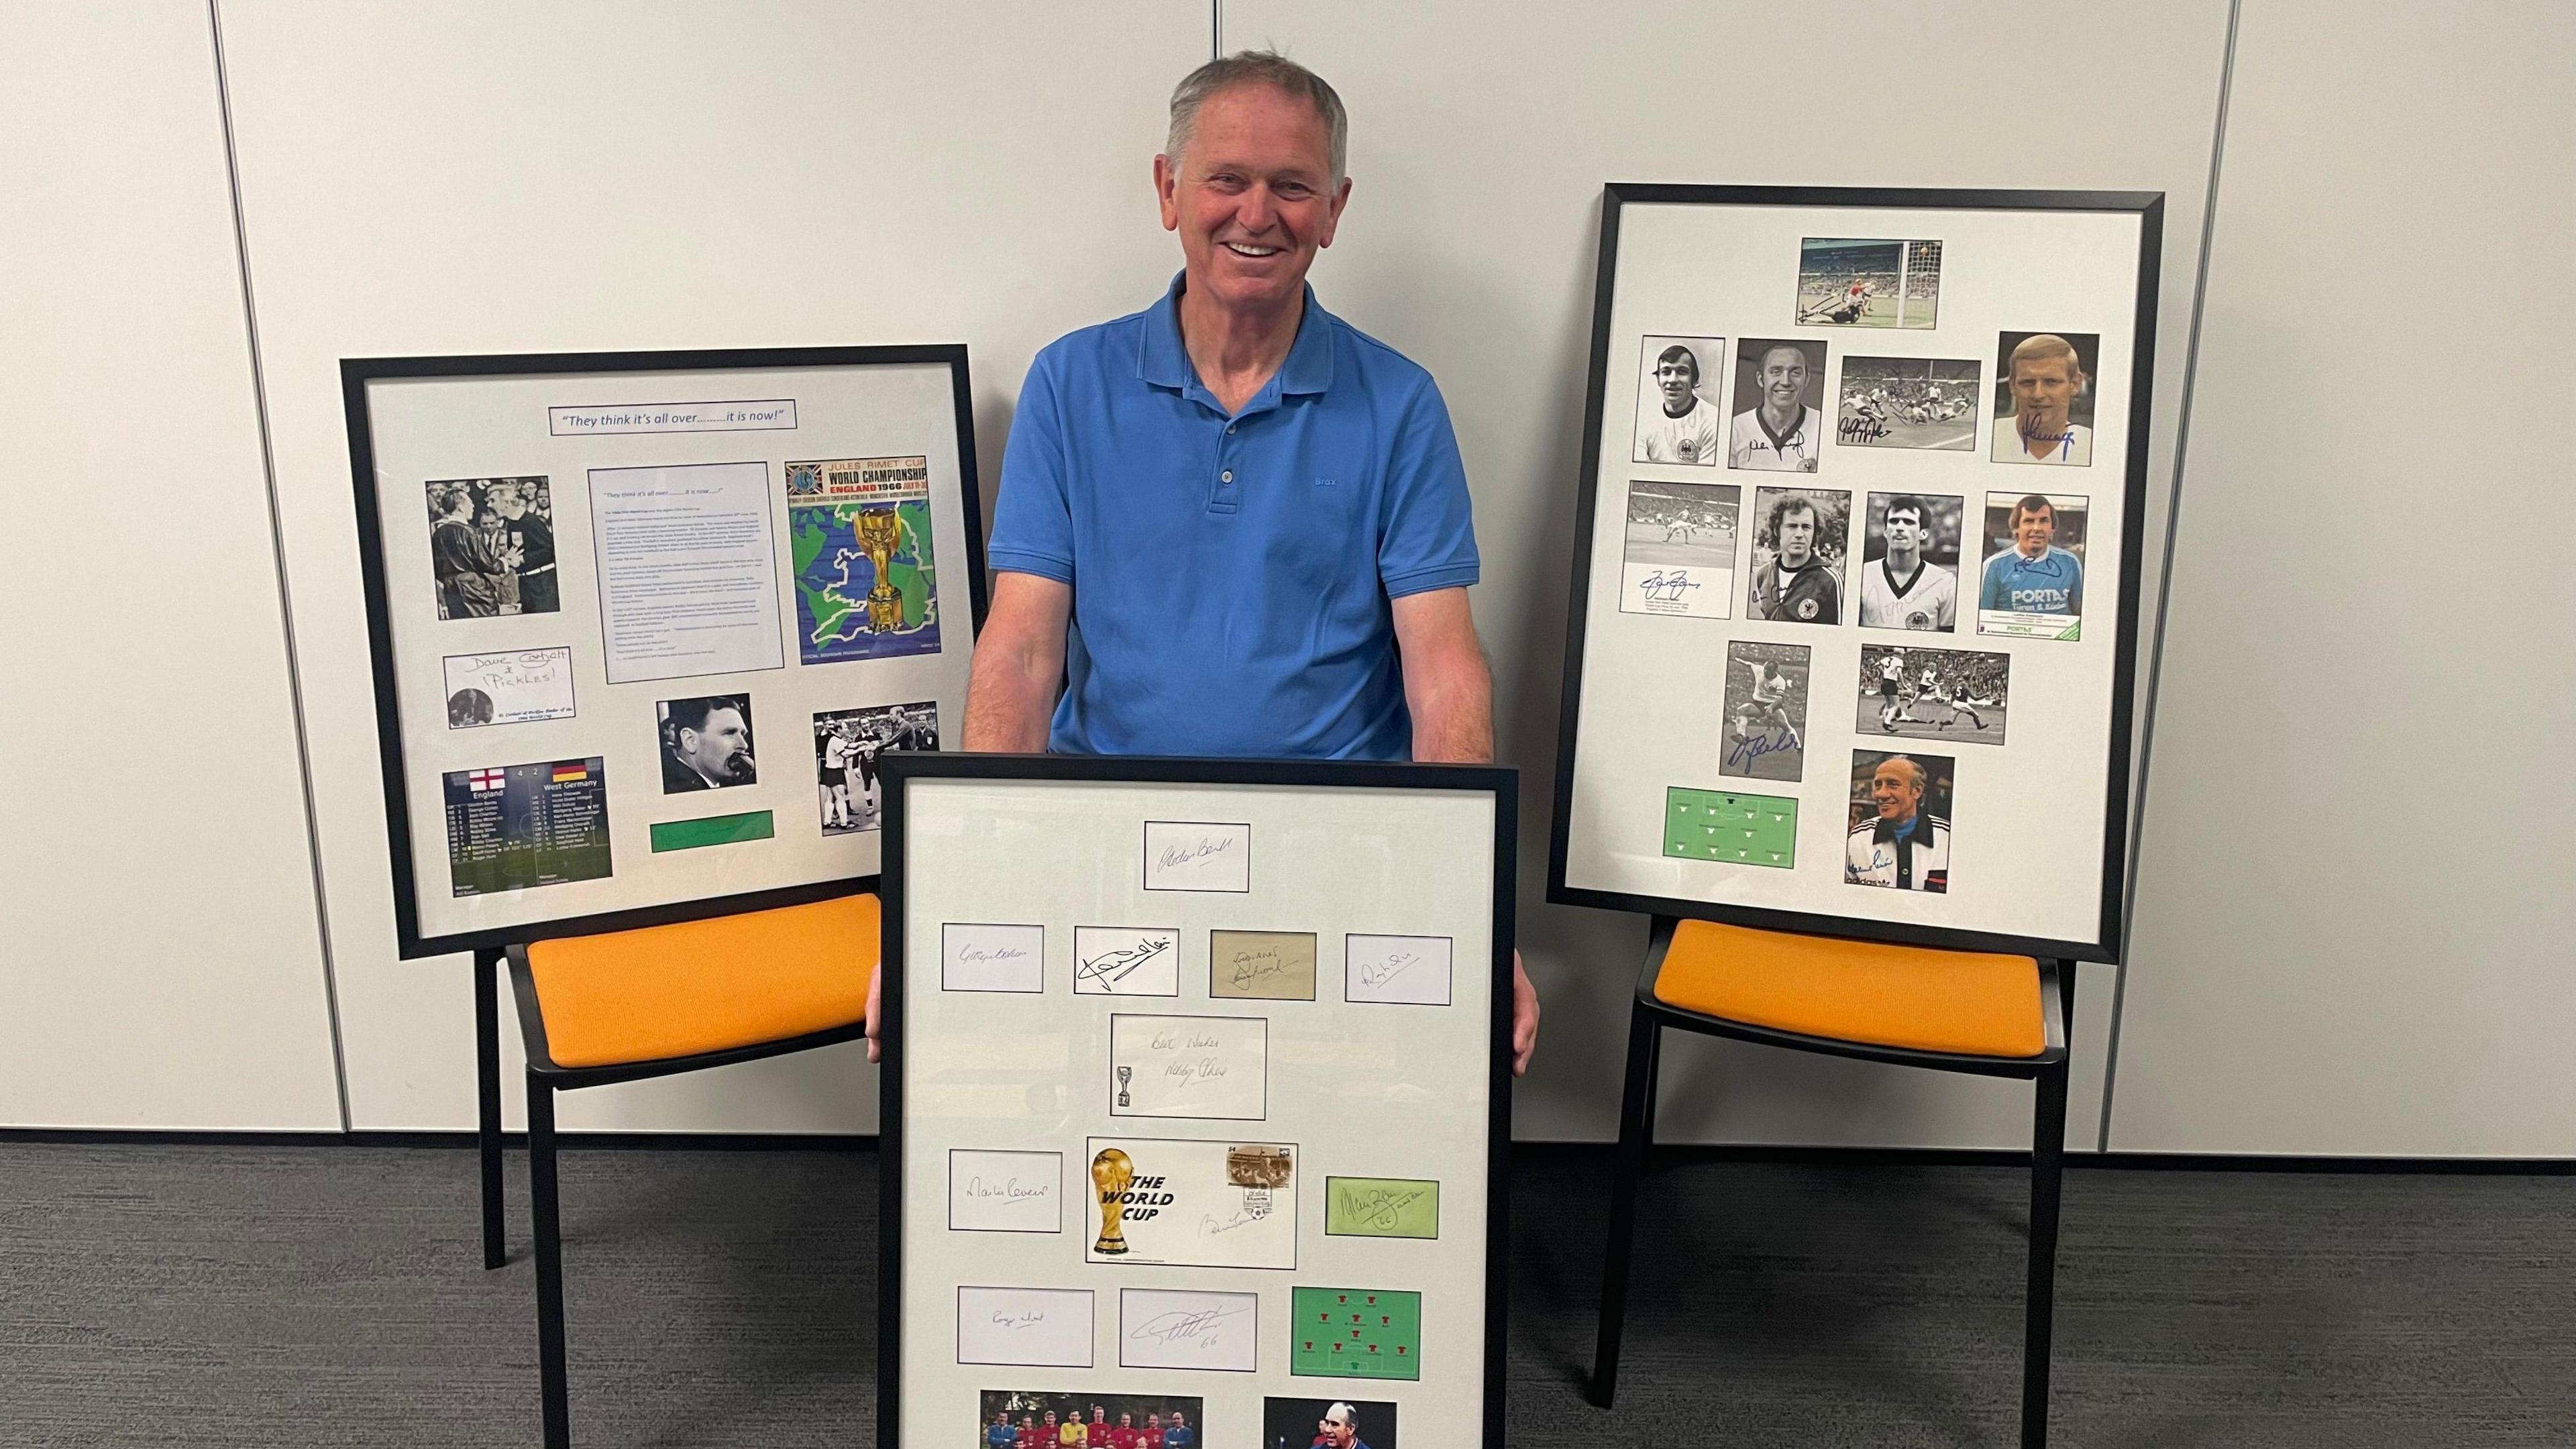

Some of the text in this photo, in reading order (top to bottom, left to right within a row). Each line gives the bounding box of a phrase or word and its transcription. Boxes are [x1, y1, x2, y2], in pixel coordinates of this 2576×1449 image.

[601, 415, 631, 425] think
[654, 413, 668, 424] all
[737, 410, 746, 421] is
[828, 462, 861, 472] JULES
[867, 460, 898, 469] RIMET
[829, 470, 859, 485] WORLD
[830, 484, 877, 494] ENGLAND
[877, 482, 902, 491] 1966
[2011, 588, 2070, 603] PORTAS
[1955, 686, 1963, 697] 5
[543, 780, 597, 791] West Germany
[473, 790, 504, 799] England
[1846, 877, 1877, 886] adidas
[1129, 1175, 1166, 1189] THE
[1101, 1191, 1174, 1205] WORLD
[1121, 1208, 1159, 1221] CUP
[1201, 1335, 1218, 1348] 66
